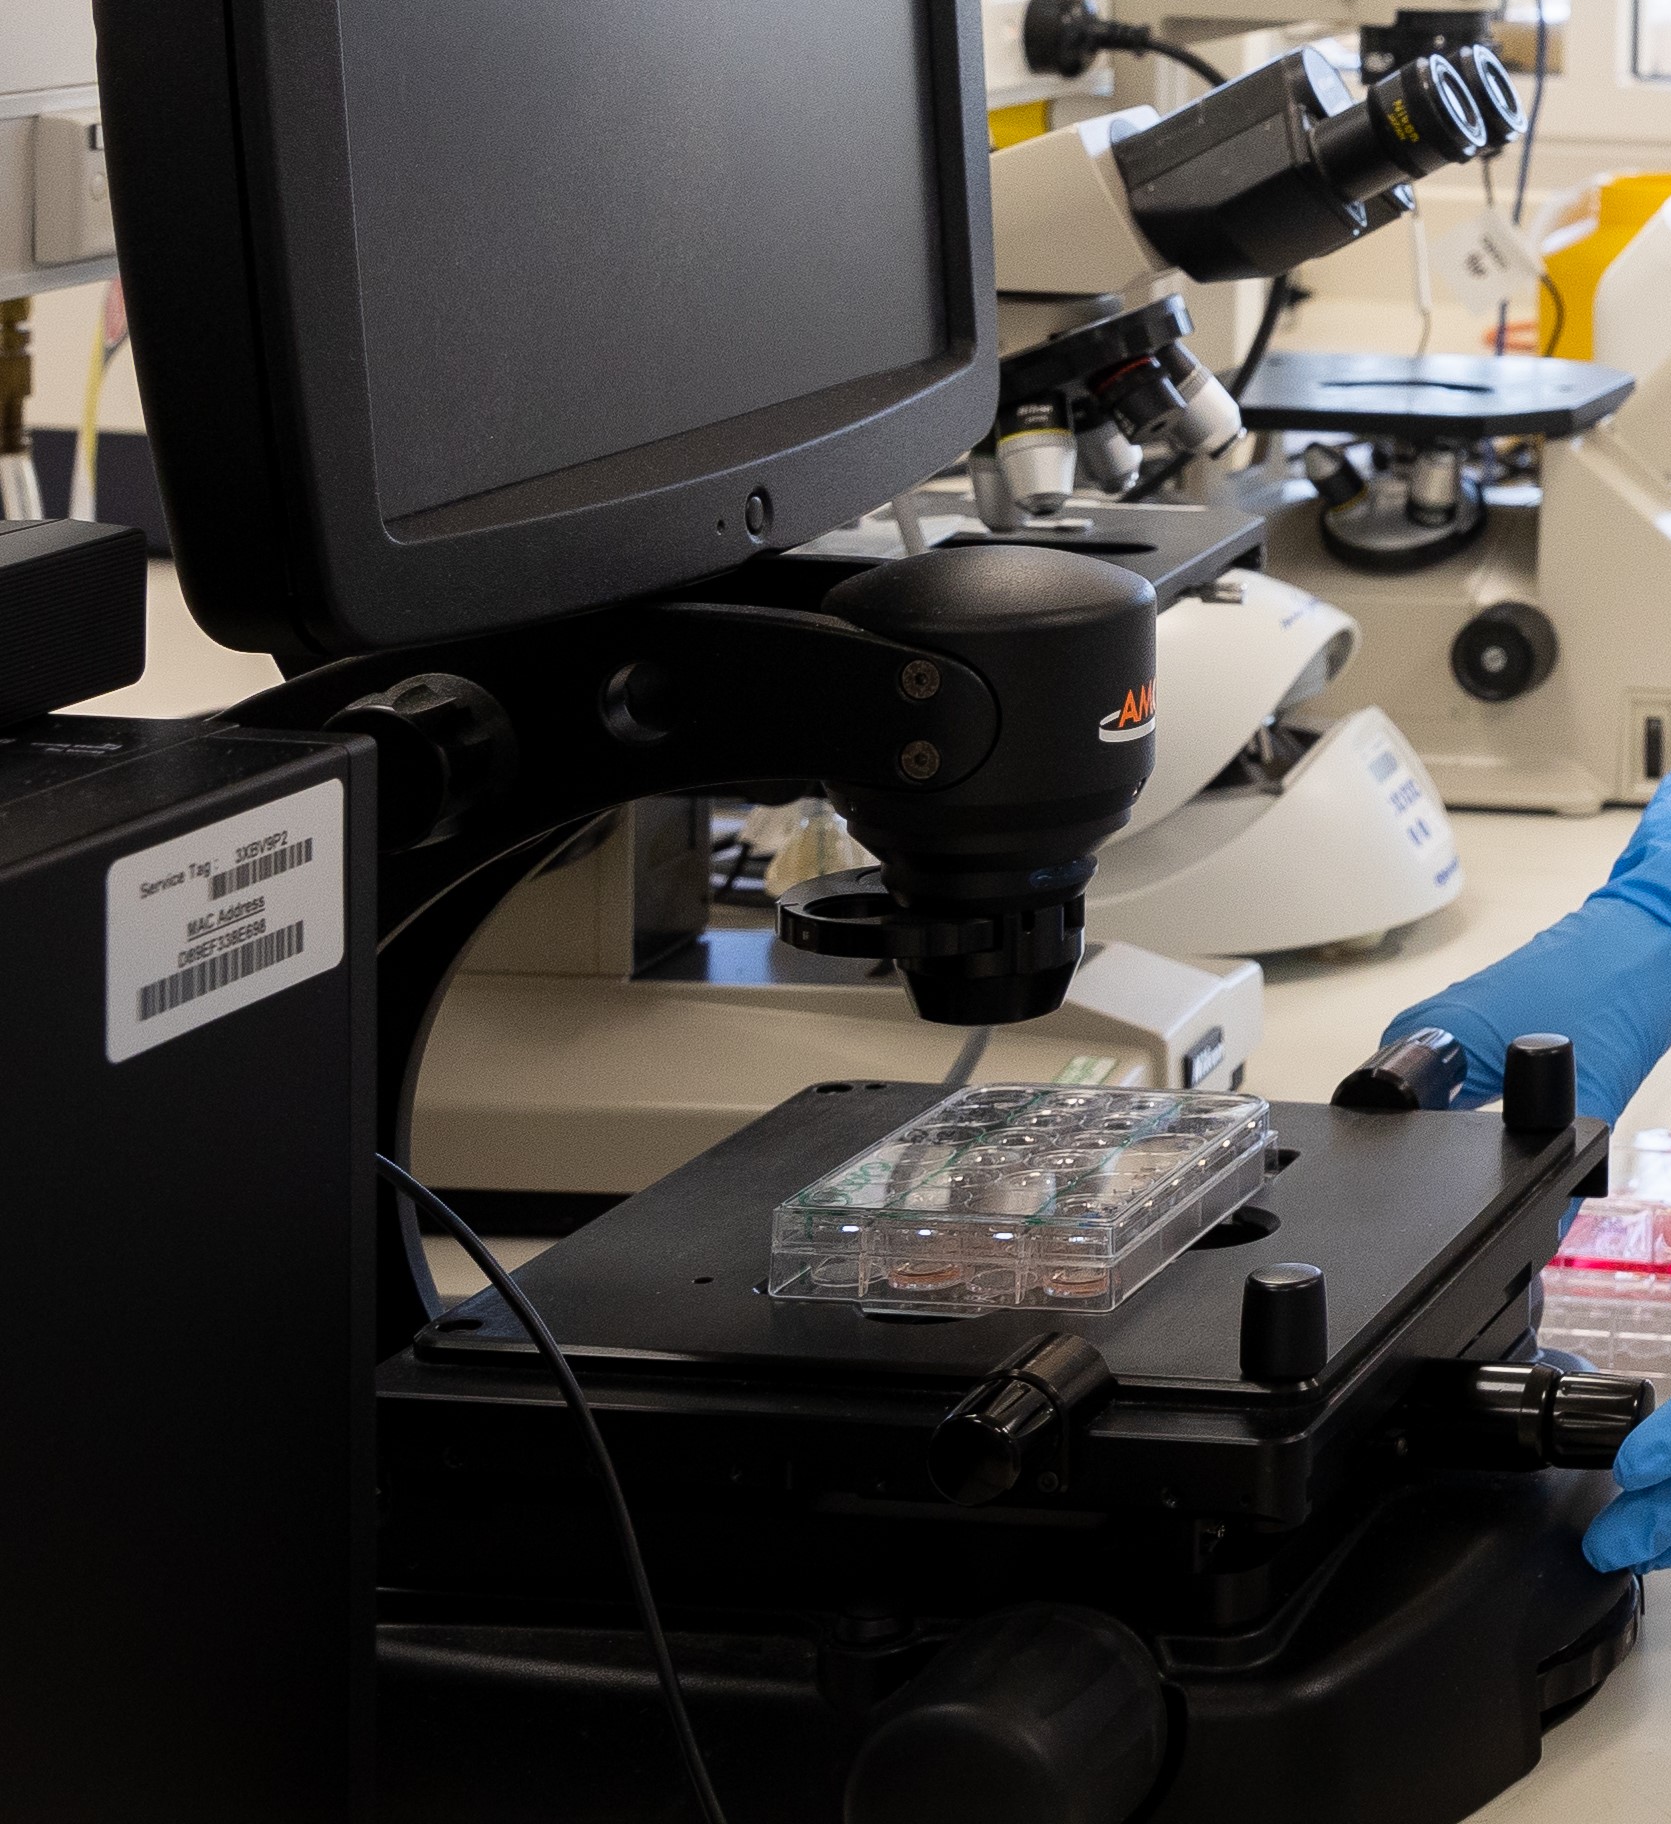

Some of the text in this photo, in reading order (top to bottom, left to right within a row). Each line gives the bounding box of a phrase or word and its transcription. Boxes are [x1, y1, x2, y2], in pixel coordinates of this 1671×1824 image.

[1118, 678, 1157, 728] AM
[140, 872, 186, 899] Service
[187, 896, 266, 938] MAC Address
